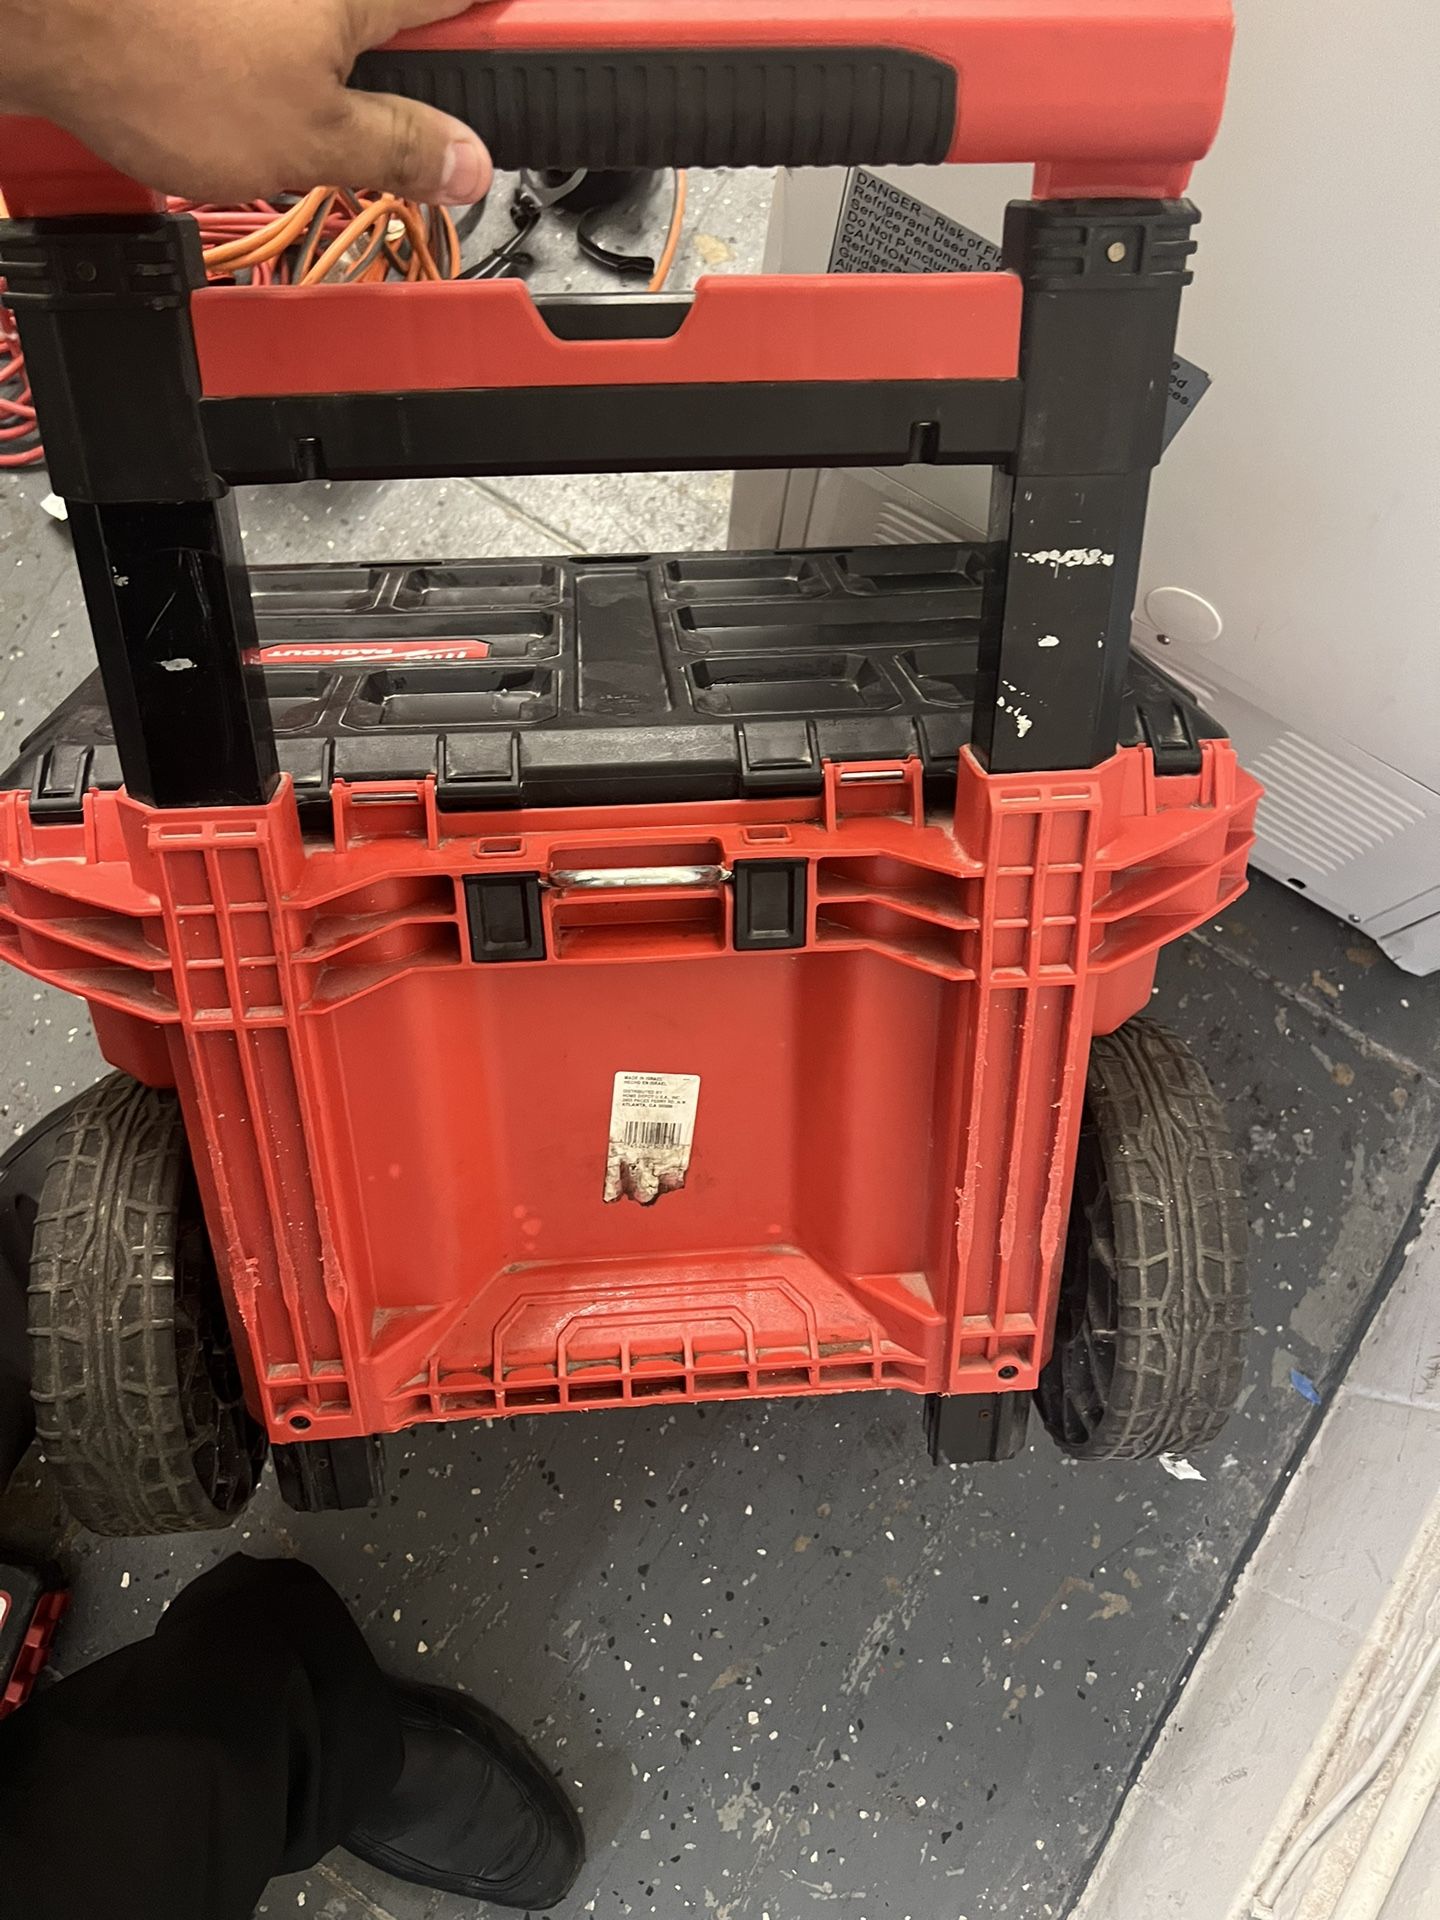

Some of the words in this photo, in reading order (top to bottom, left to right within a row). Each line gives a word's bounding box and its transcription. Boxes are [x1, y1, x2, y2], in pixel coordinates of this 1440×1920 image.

[847, 210, 866, 228] Do
[869, 220, 892, 243] Not
[851, 198, 900, 233] Service
[853, 185, 930, 236] Refrigerant
[933, 230, 970, 261] Used.
[976, 255, 991, 272] To
[839, 247, 875, 273] Guide
[841, 234, 908, 273] Refrigera
[967, 238, 982, 253] of
[985, 245, 1003, 262] Fir
